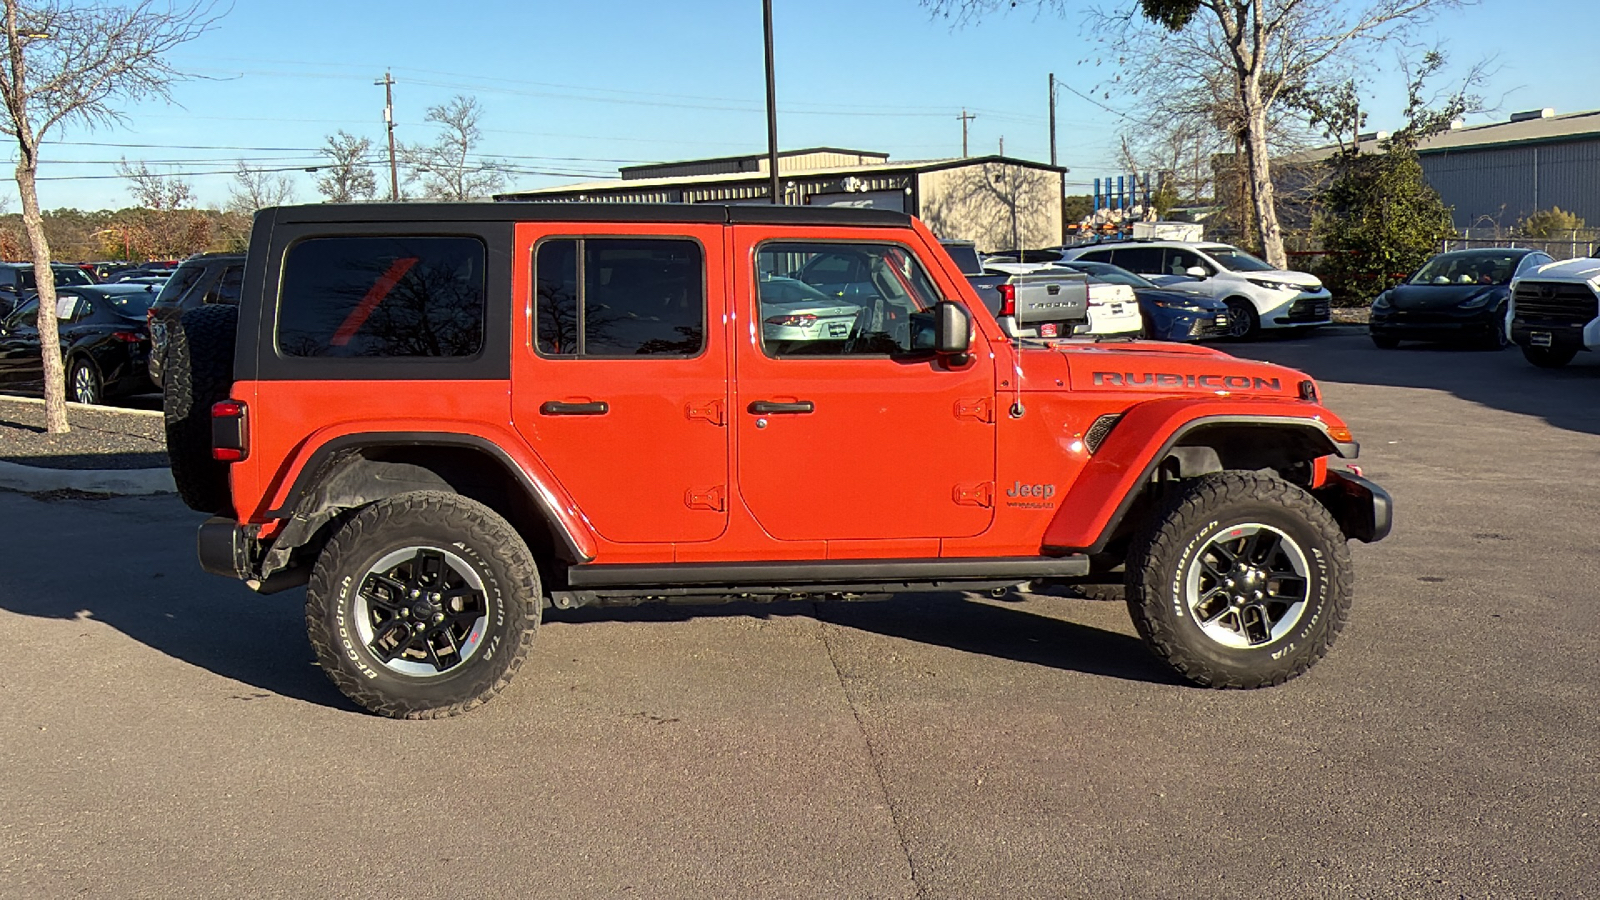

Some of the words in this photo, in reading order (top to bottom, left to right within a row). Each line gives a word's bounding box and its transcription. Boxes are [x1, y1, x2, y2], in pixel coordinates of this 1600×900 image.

[1028, 301, 1079, 309] TACOMA
[1092, 371, 1281, 390] RUBICON
[1006, 480, 1054, 500] Jeep
[335, 575, 379, 680] BFGoodrich
[1271, 642, 1297, 661] T/A
